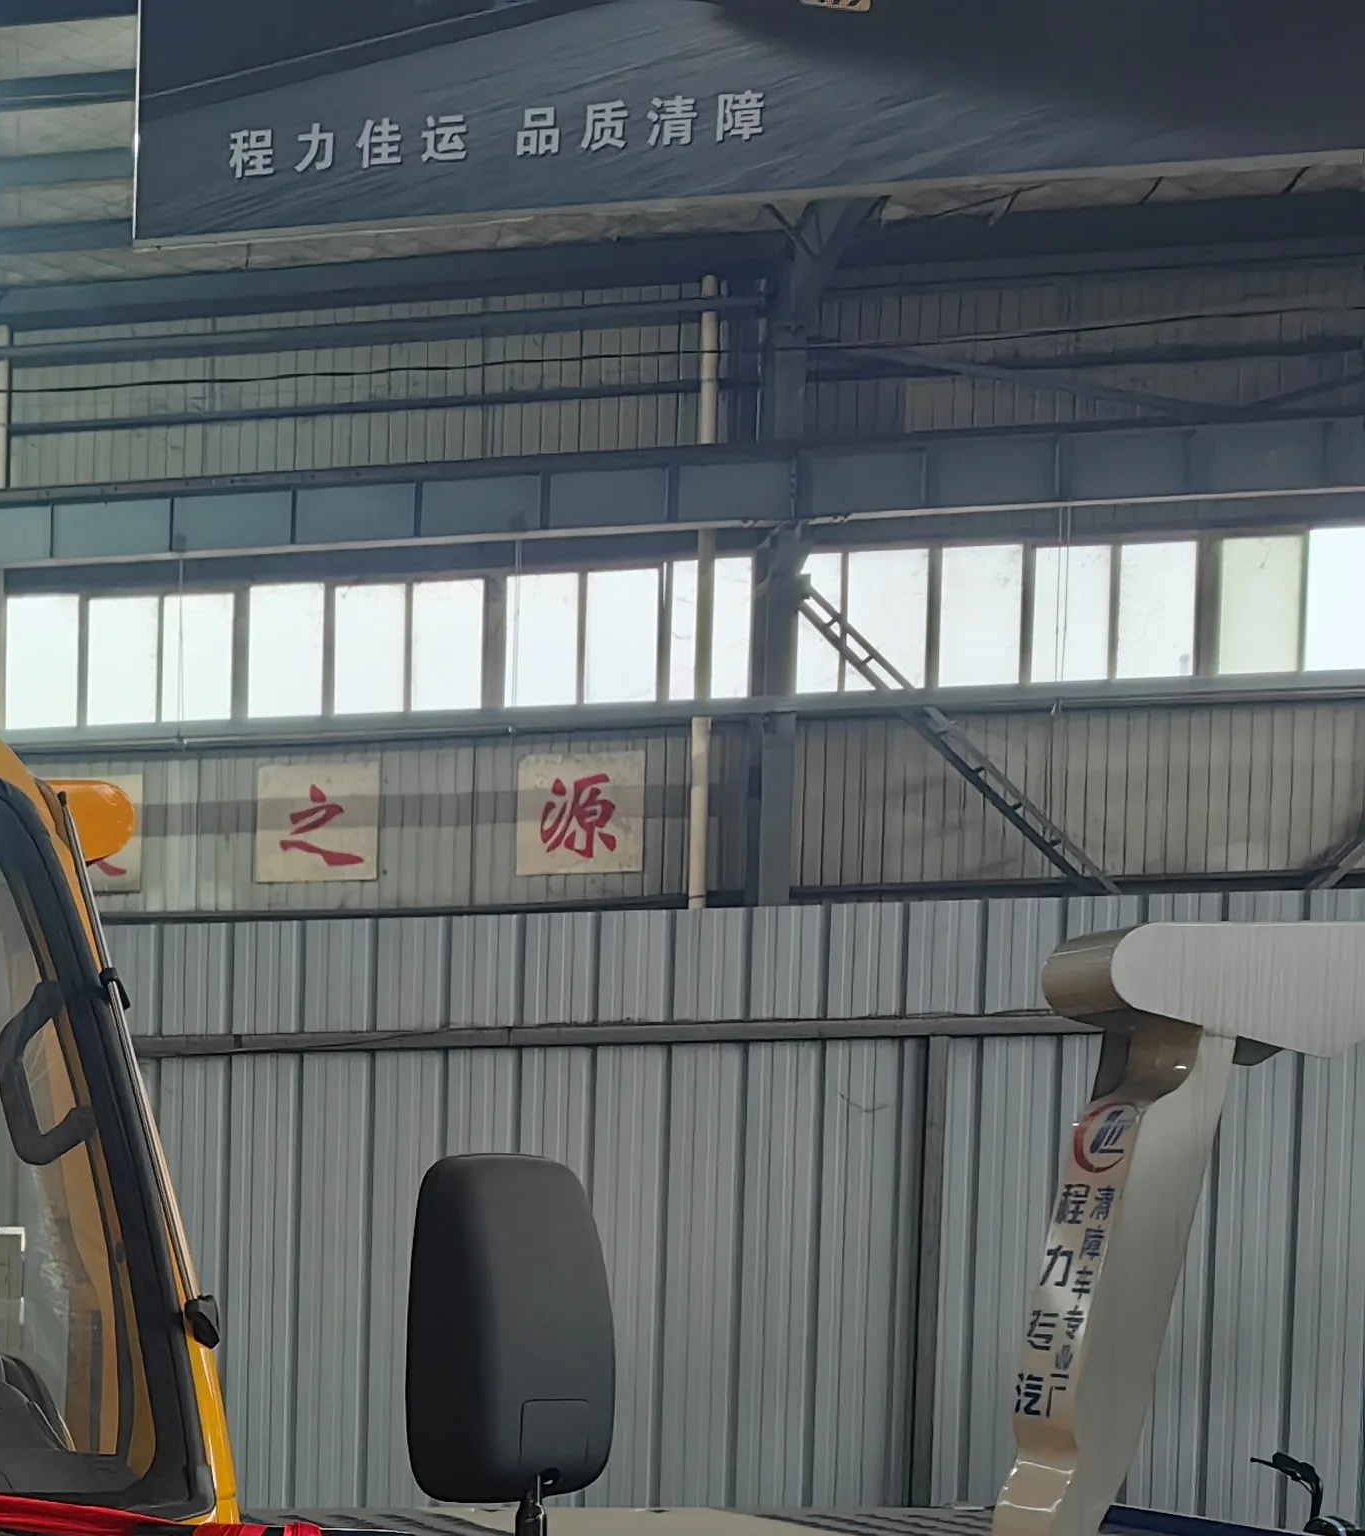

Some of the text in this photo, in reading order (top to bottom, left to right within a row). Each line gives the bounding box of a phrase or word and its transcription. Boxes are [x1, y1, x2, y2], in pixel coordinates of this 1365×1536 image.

[228, 89, 766, 180] 程力佳运 品质清障
